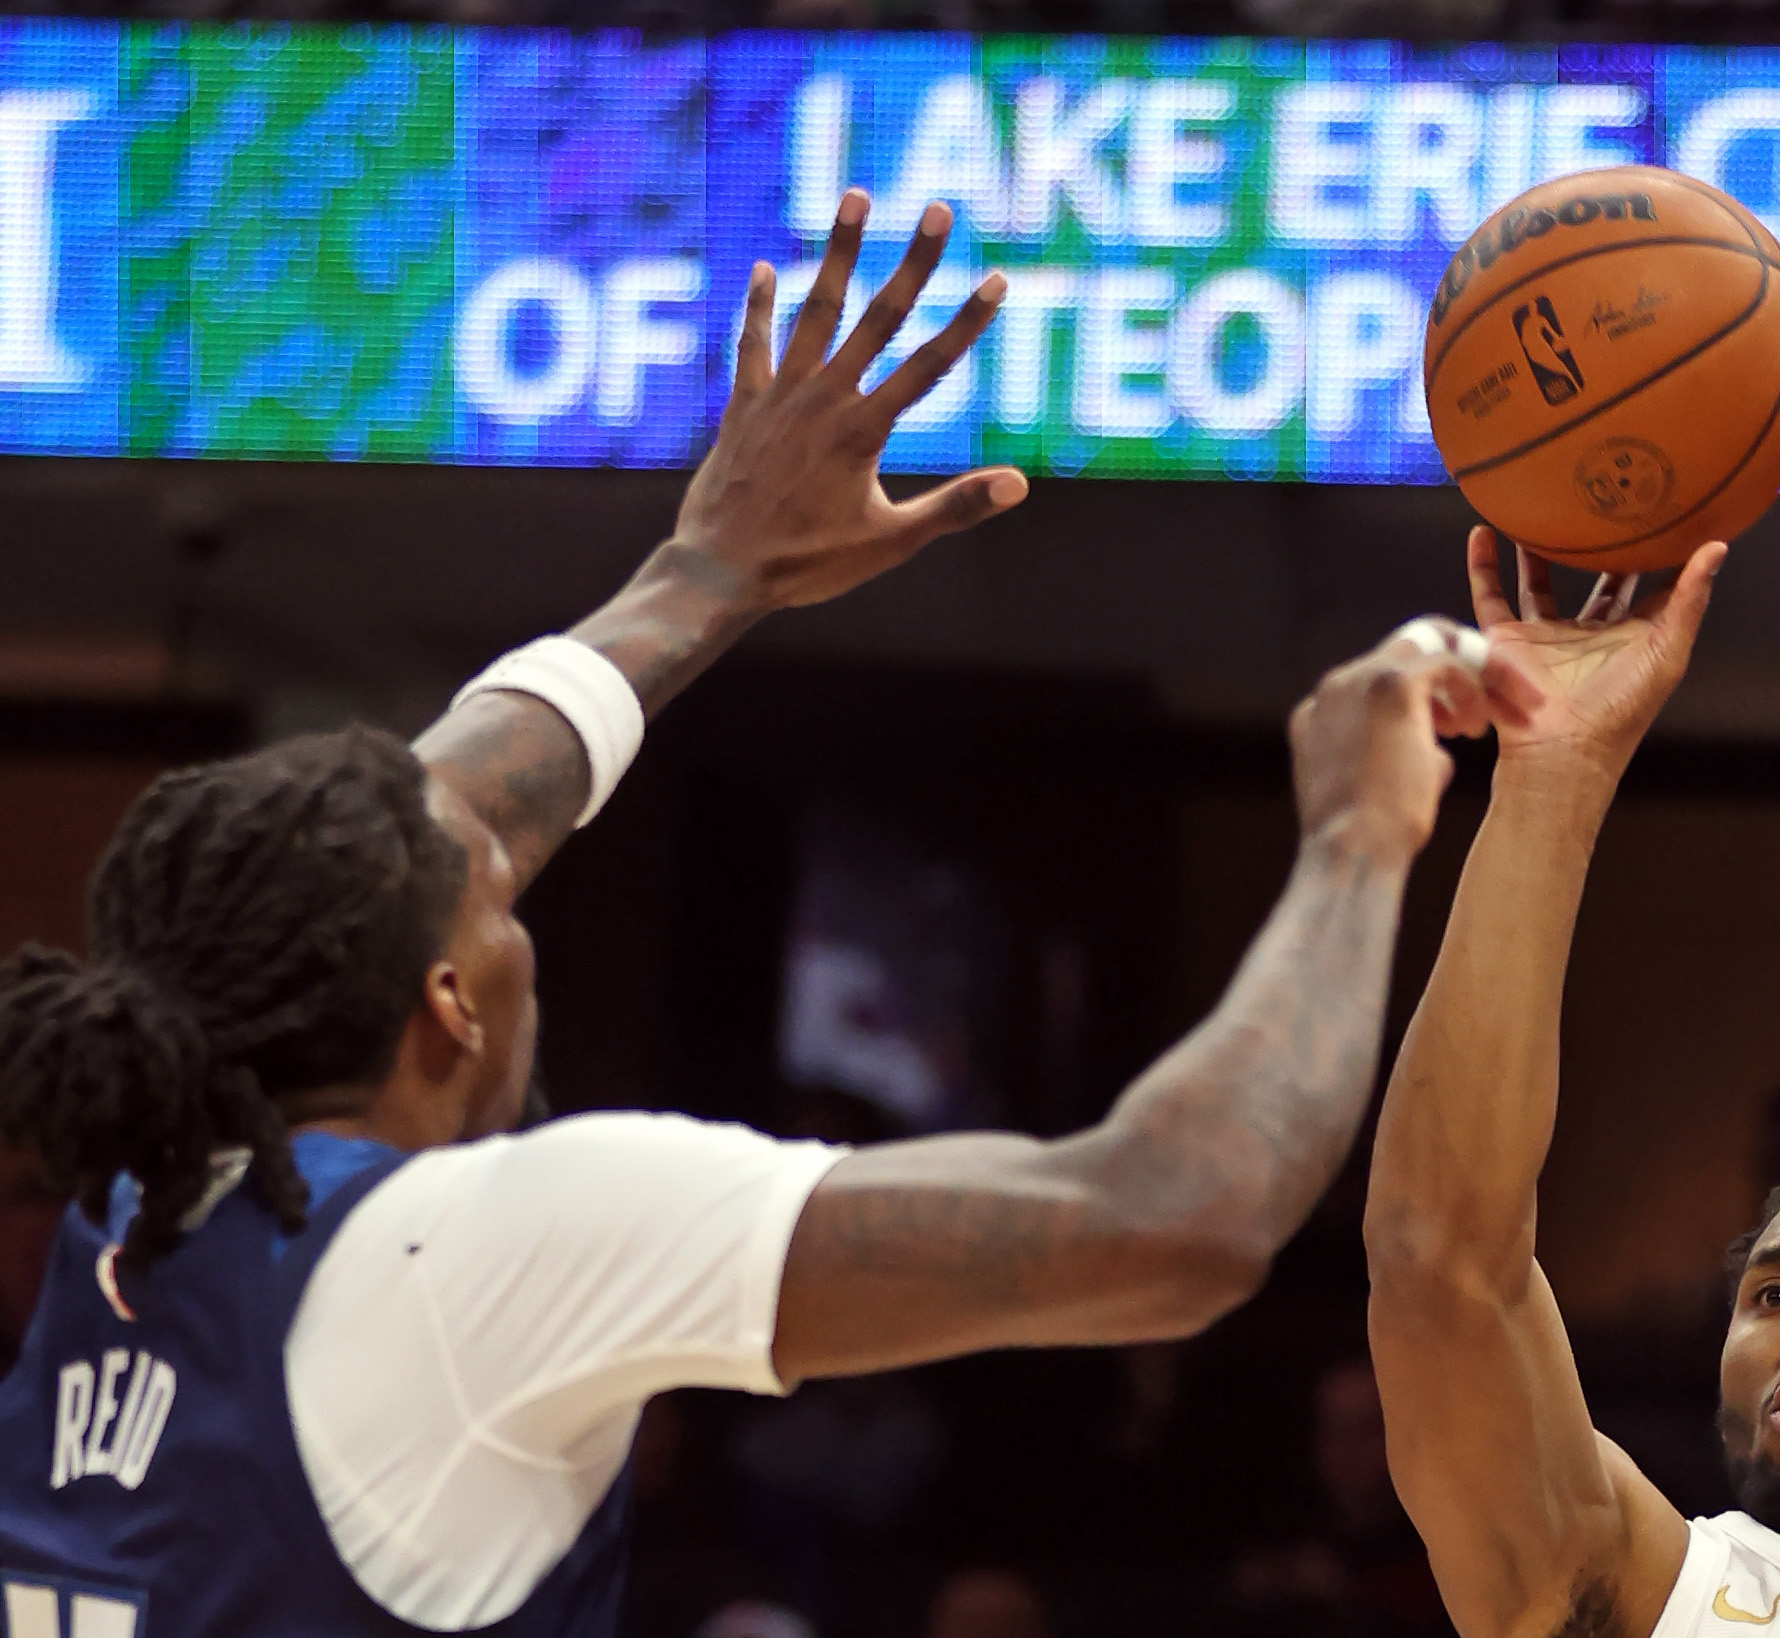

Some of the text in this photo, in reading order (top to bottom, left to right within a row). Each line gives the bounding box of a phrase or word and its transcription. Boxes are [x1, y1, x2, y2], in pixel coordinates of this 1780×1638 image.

[787, 75, 1234, 250] LAKE
[1271, 82, 1650, 248] ERIE
[455, 255, 703, 427] OF
[51, 1346, 177, 1491] REID
